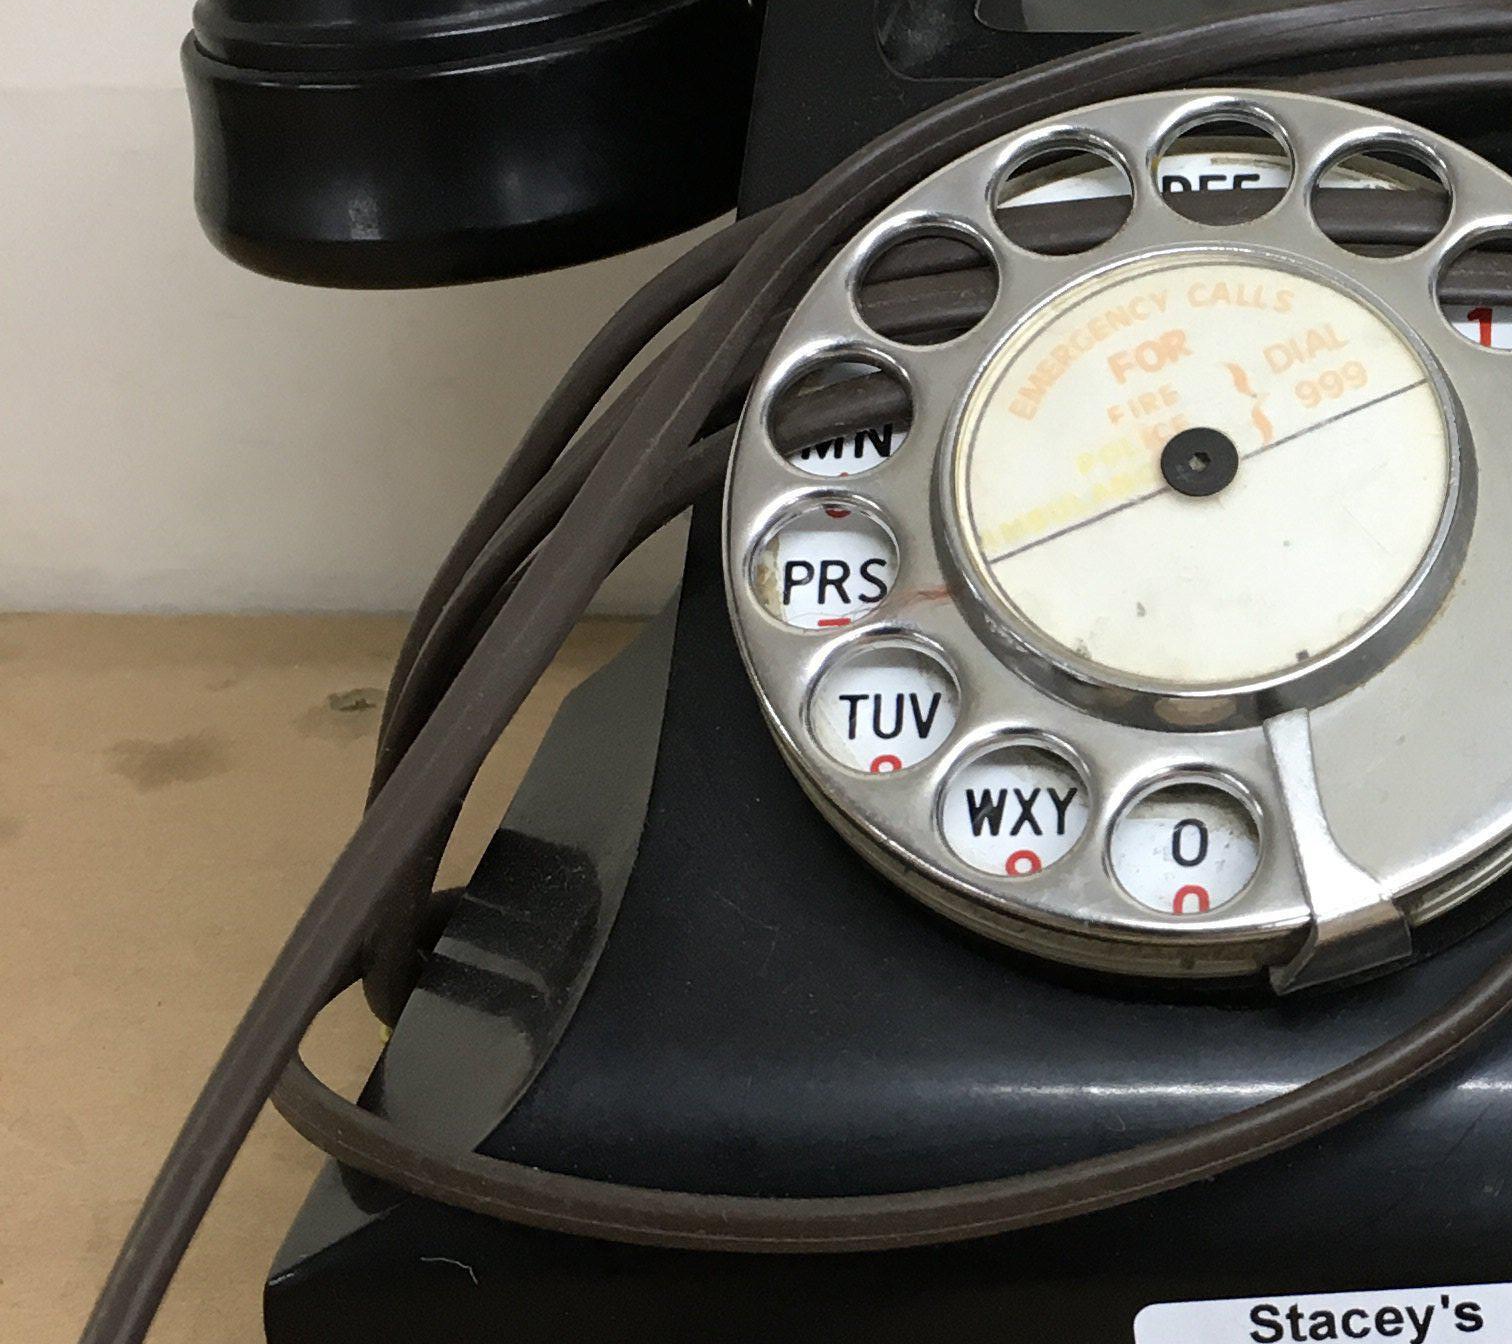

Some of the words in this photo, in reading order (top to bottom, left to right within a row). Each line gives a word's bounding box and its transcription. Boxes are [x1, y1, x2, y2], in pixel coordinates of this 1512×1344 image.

[1186, 281, 1295, 315] CALLS
[1262, 322, 1348, 376] DIAL
[1467, 307, 1492, 348] 1
[1107, 328, 1195, 385] FOR
[1107, 382, 1180, 426] FIRE
[1294, 360, 1369, 409] 999
[782, 558, 889, 605] PRS
[839, 691, 942, 740] TUV
[966, 786, 1078, 838] WXY
